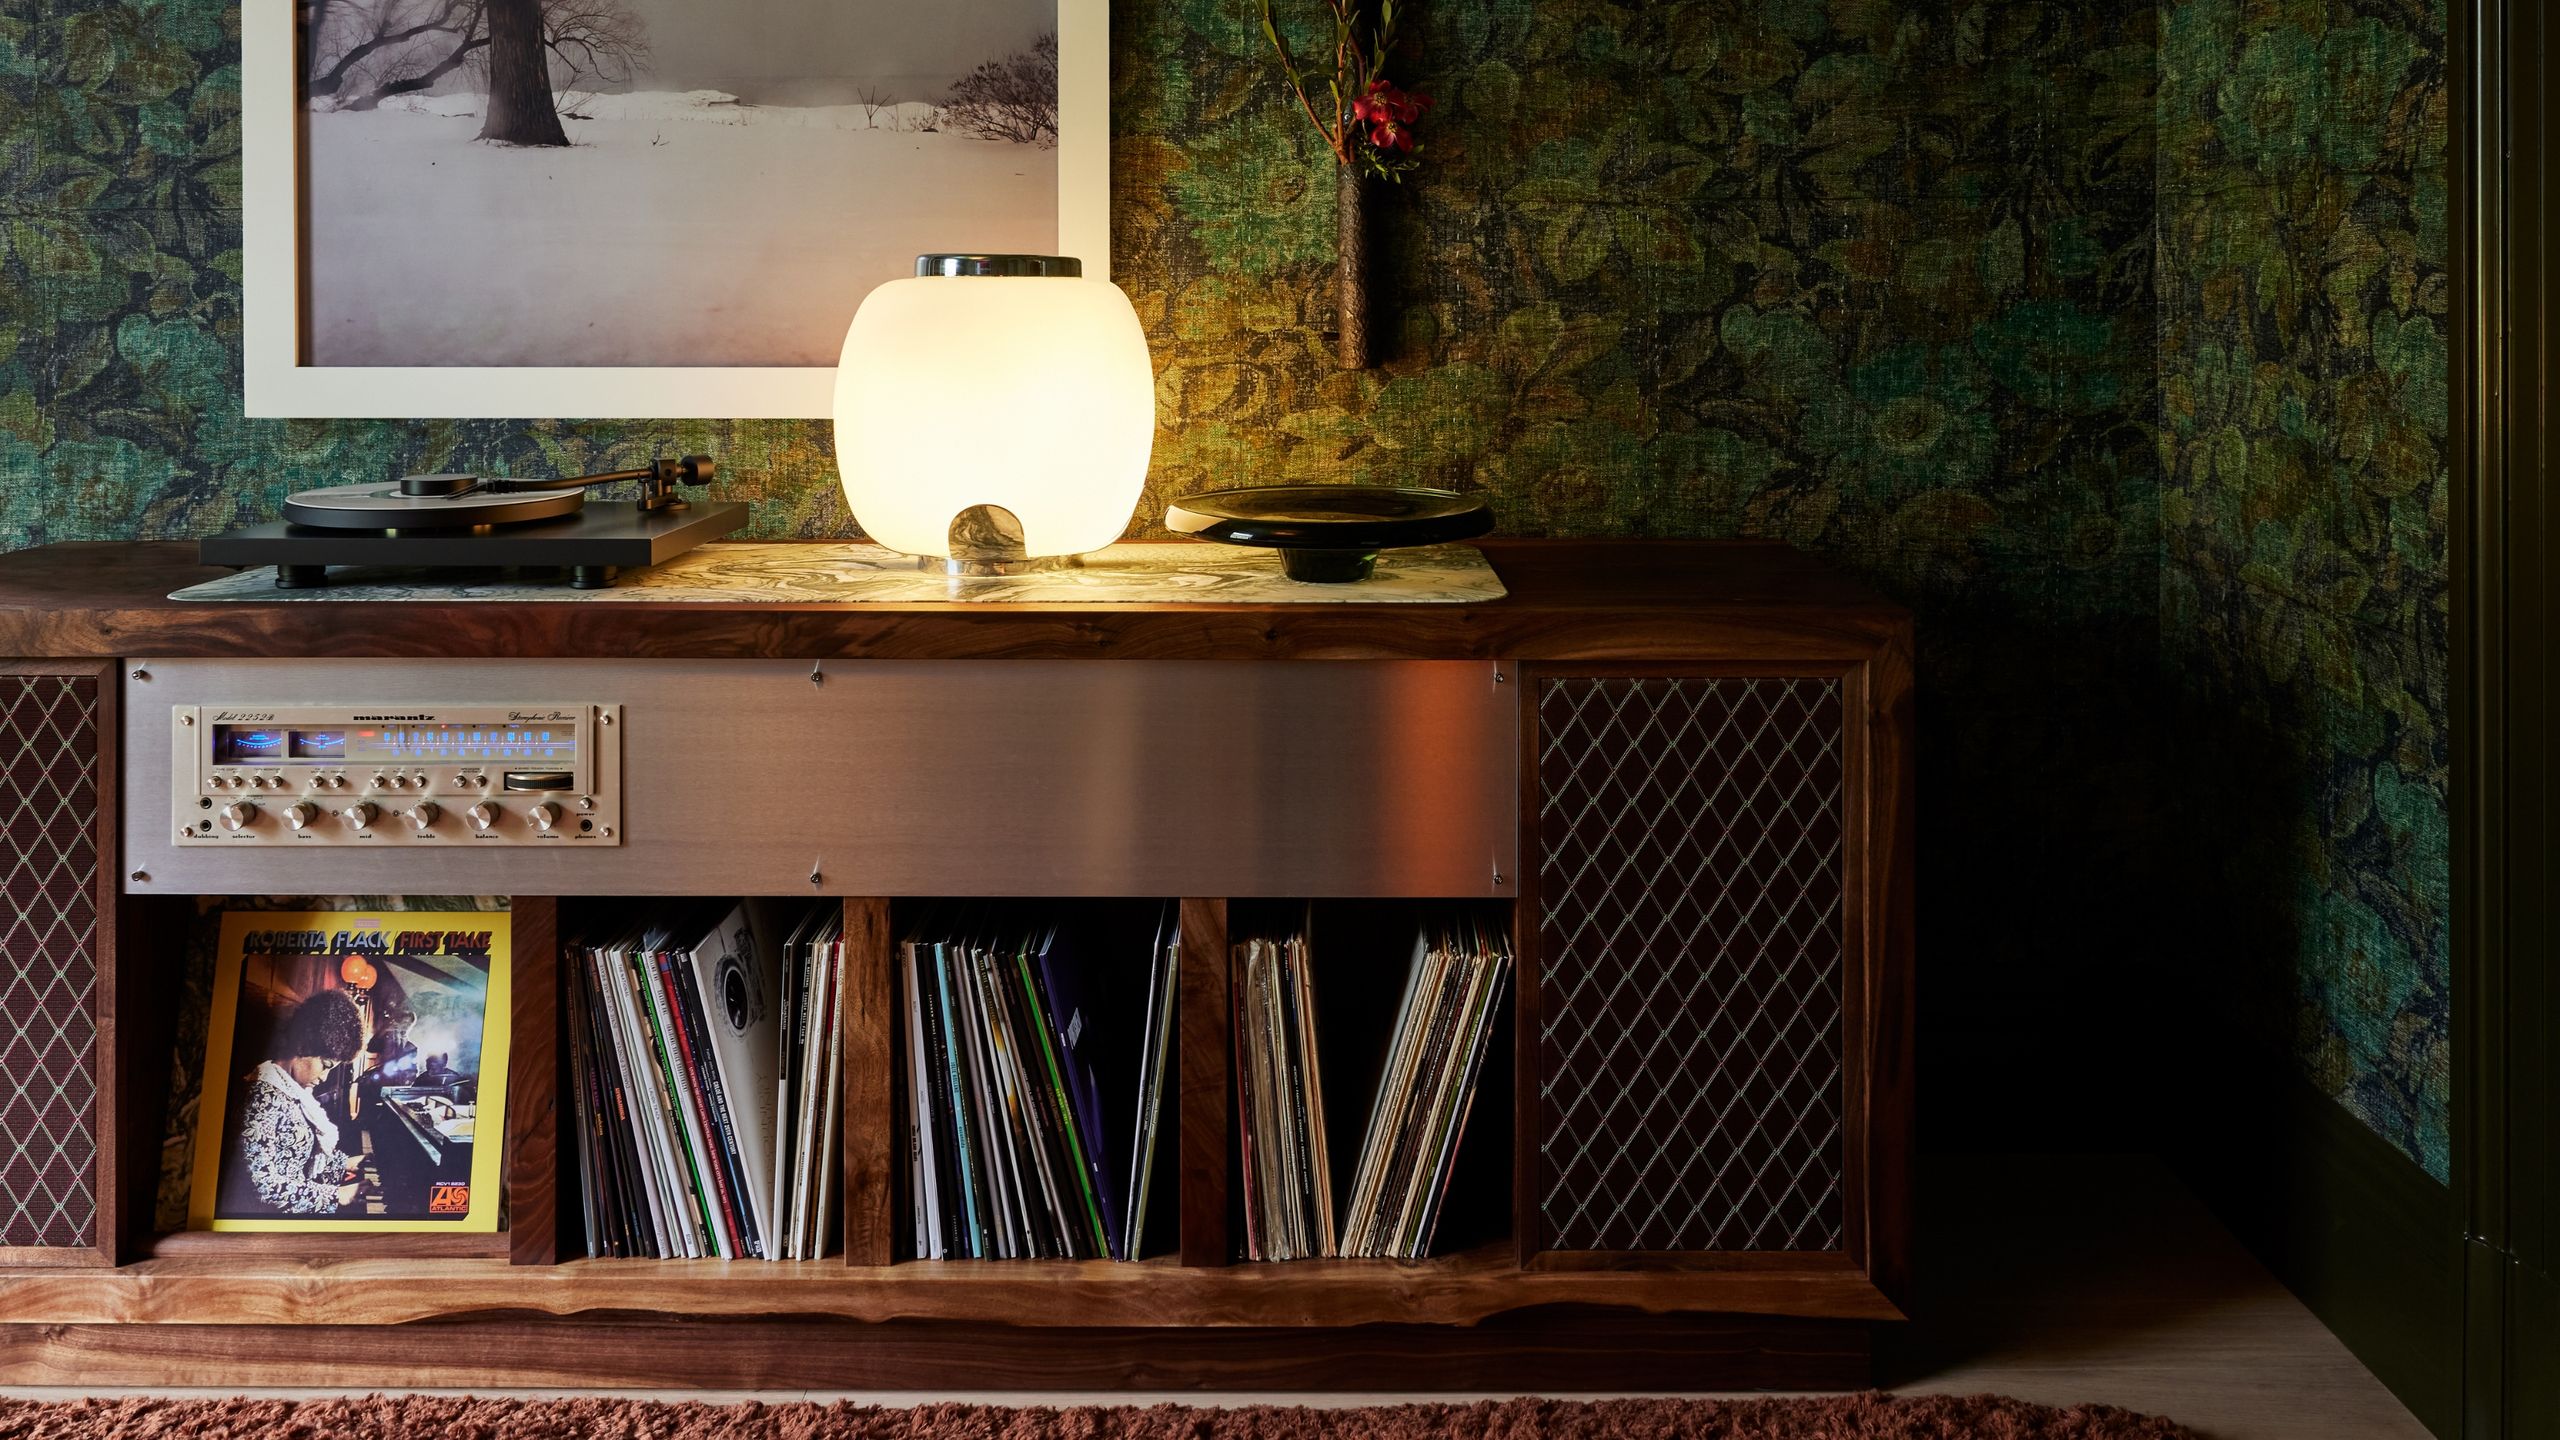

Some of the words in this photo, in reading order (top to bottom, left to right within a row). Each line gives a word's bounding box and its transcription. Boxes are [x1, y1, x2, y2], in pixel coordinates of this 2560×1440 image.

[212, 711, 236, 721] Model
[247, 930, 329, 949] ROBERTA
[335, 930, 392, 949] FLACK
[399, 930, 445, 949] FIRST
[448, 930, 493, 949] TAKE
[720, 1112, 729, 1124] NEXT
[726, 1135, 737, 1154] CENTURY
